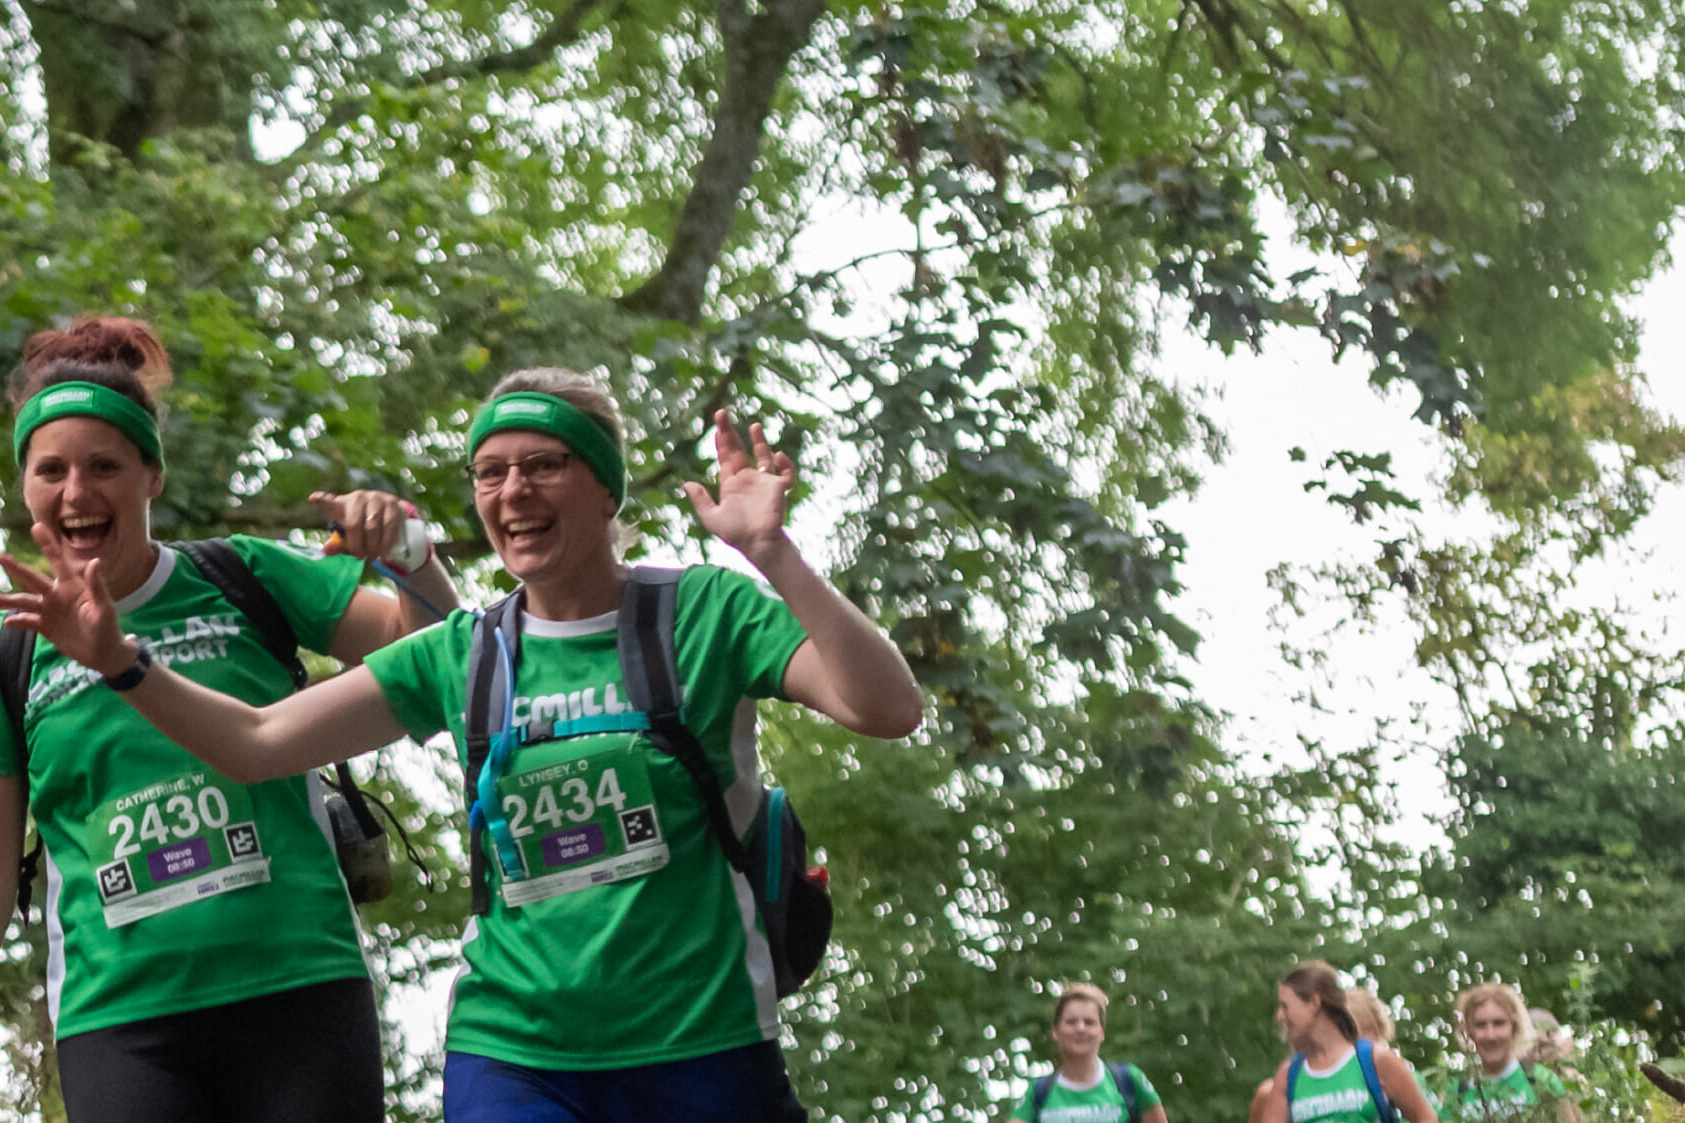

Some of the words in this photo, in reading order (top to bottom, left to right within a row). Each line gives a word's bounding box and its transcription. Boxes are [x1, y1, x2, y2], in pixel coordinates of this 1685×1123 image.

[192, 773, 205, 786] W
[502, 767, 627, 839] 2434
[108, 786, 229, 860] 2430
[557, 833, 587, 847] Wave
[163, 847, 192, 863] Wave
